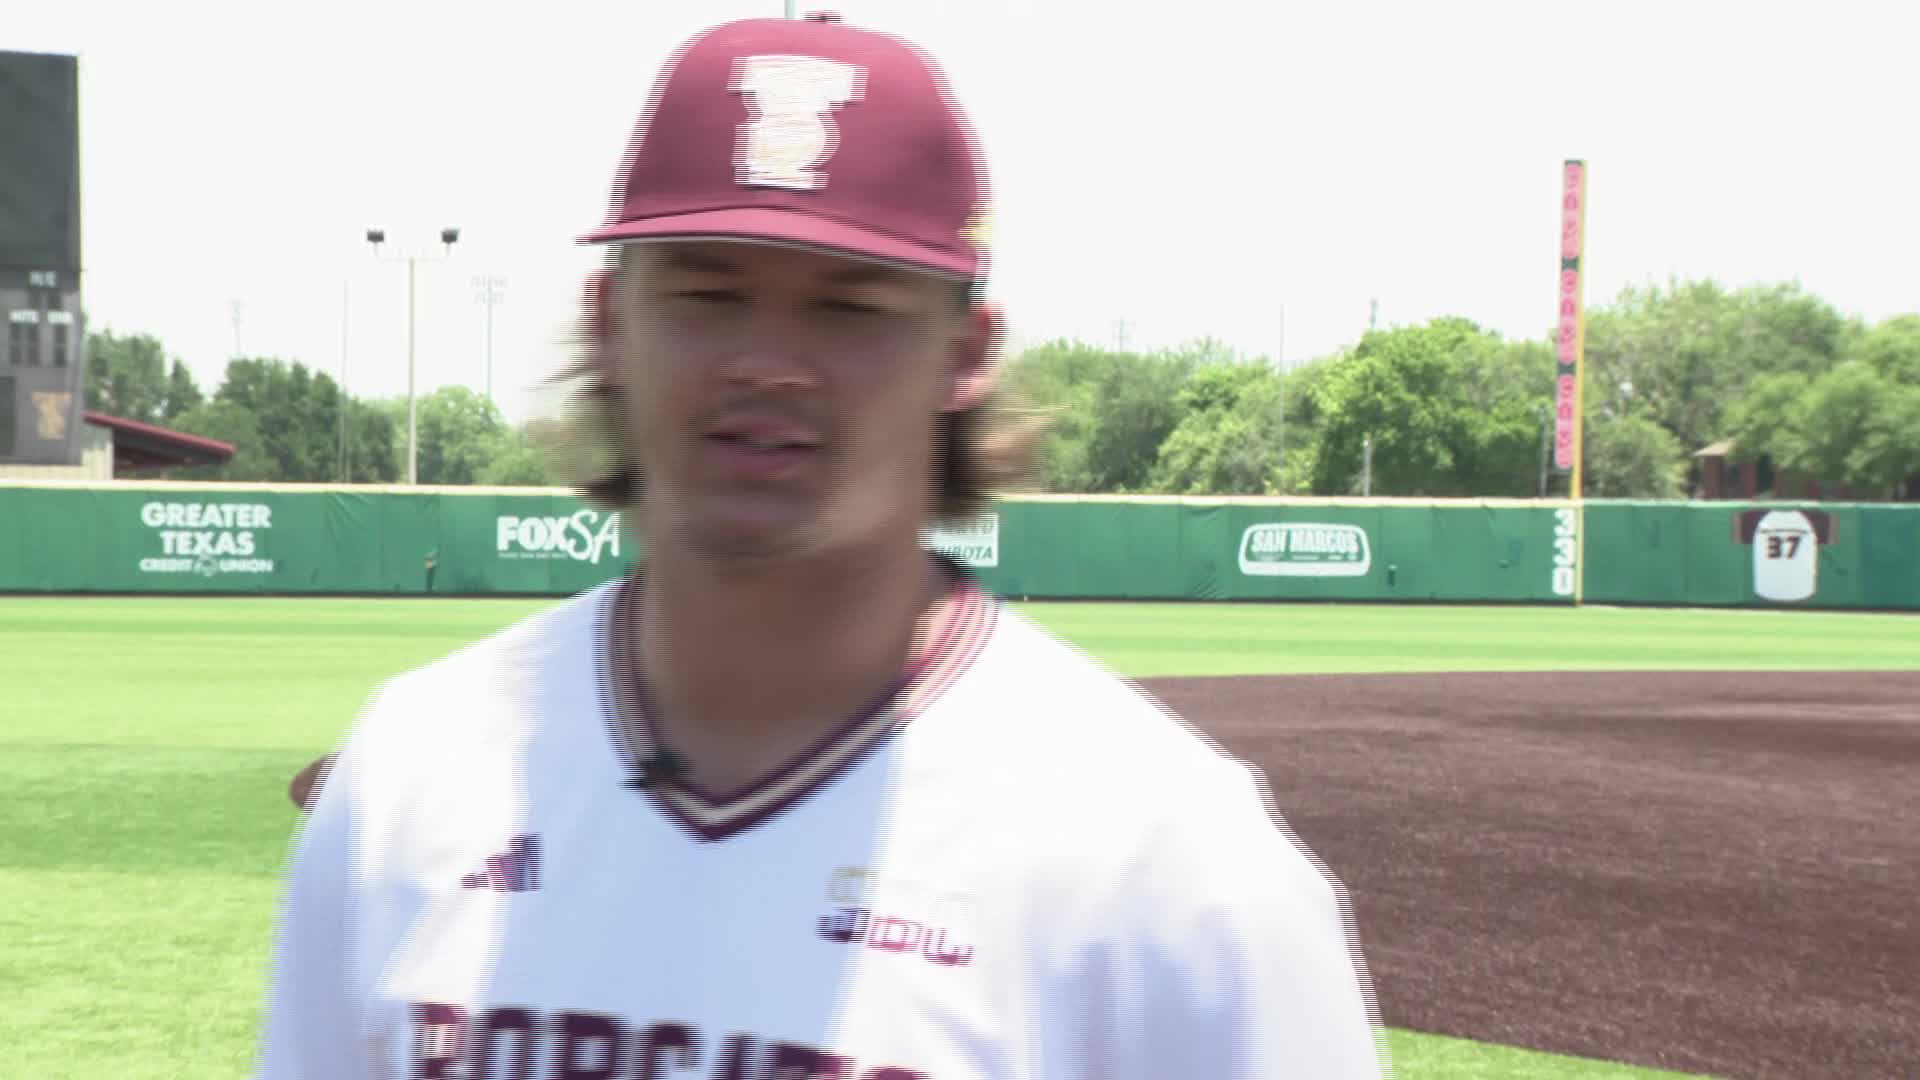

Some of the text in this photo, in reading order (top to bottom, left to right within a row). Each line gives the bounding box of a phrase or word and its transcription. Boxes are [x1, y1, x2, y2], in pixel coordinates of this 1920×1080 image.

[141, 502, 272, 528] GREATER
[160, 531, 255, 556] TEXAS
[1251, 528, 1359, 553] SAN MARCOS
[1552, 508, 1576, 596] 330
[1767, 535, 1802, 559] 37
